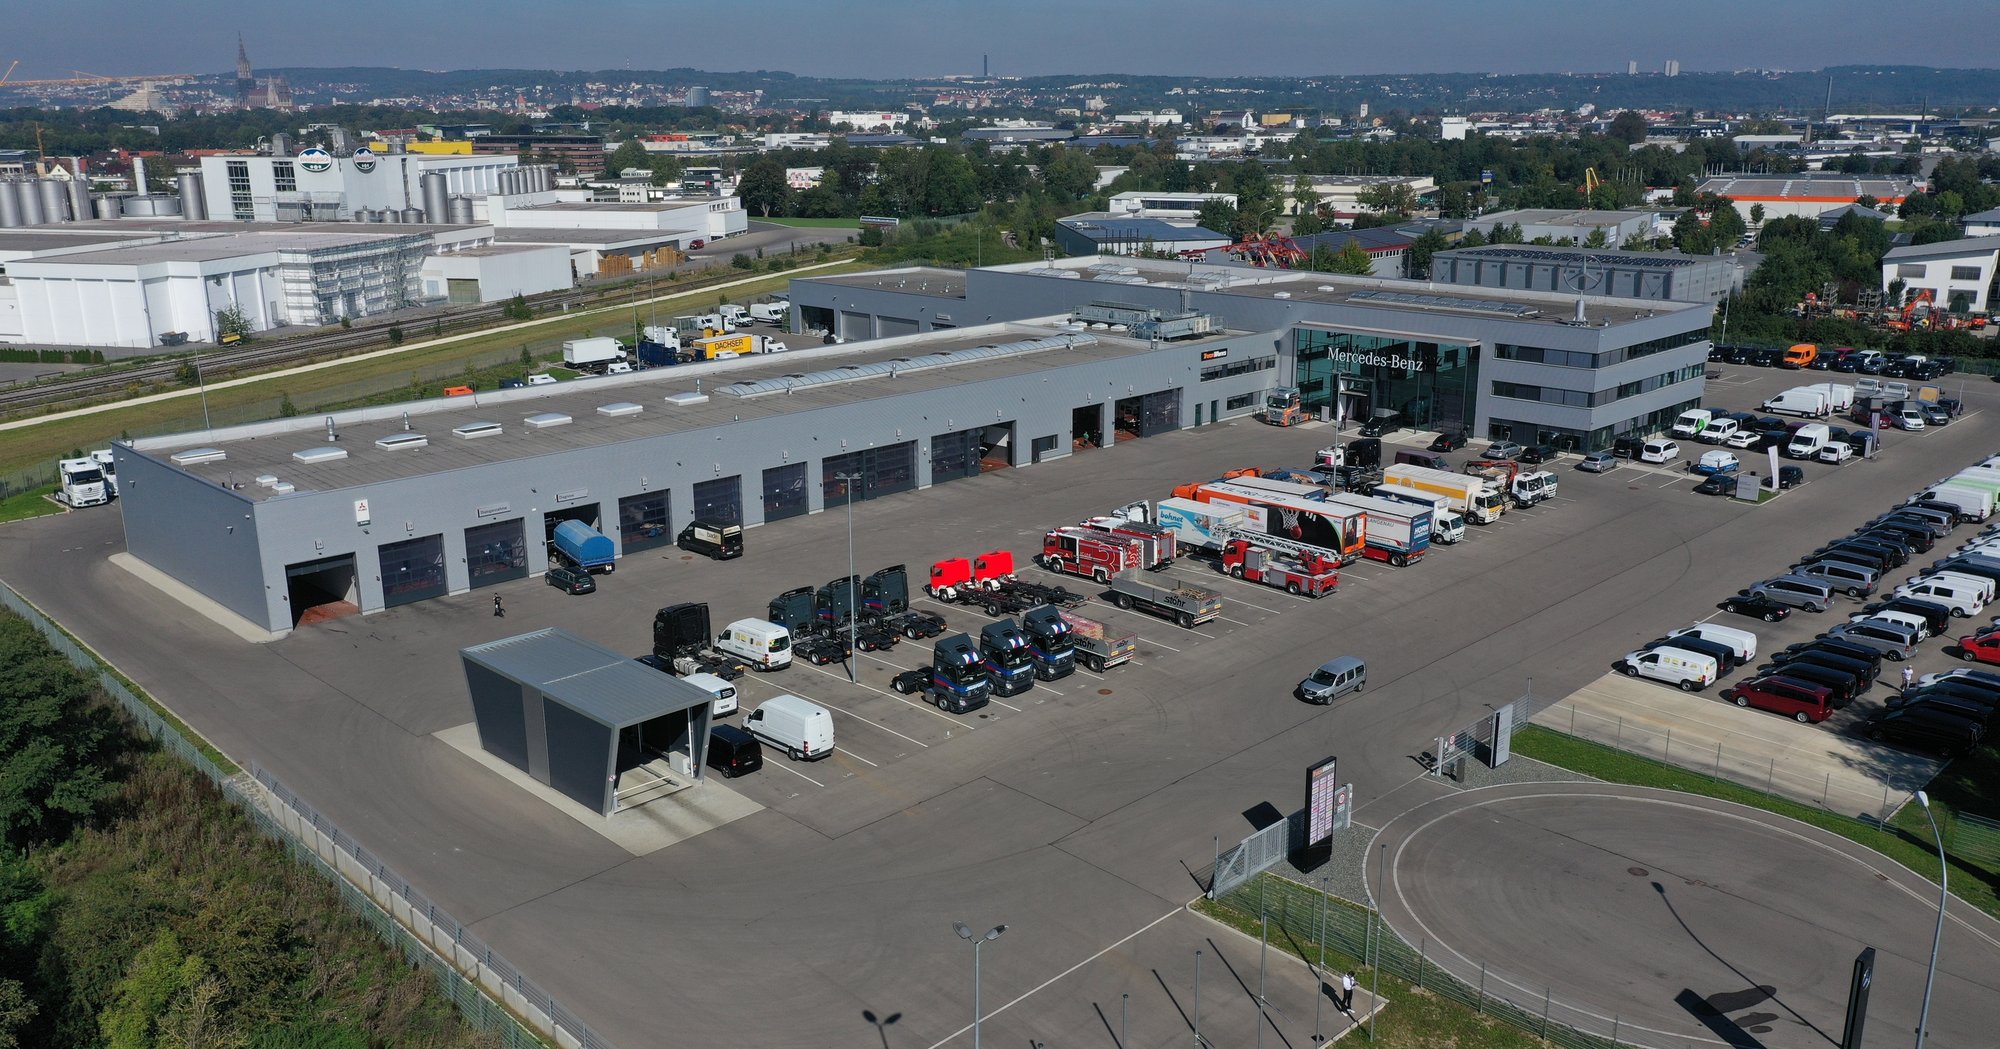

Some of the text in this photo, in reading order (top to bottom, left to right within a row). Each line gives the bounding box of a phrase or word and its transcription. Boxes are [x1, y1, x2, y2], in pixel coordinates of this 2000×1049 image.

[714, 338, 744, 350] DACHSER
[1327, 346, 1424, 372] Mercedes-Benz
[1160, 510, 1184, 523] bohnet
[1164, 594, 1186, 608] stöhr
[1074, 638, 1096, 650] stöhr
